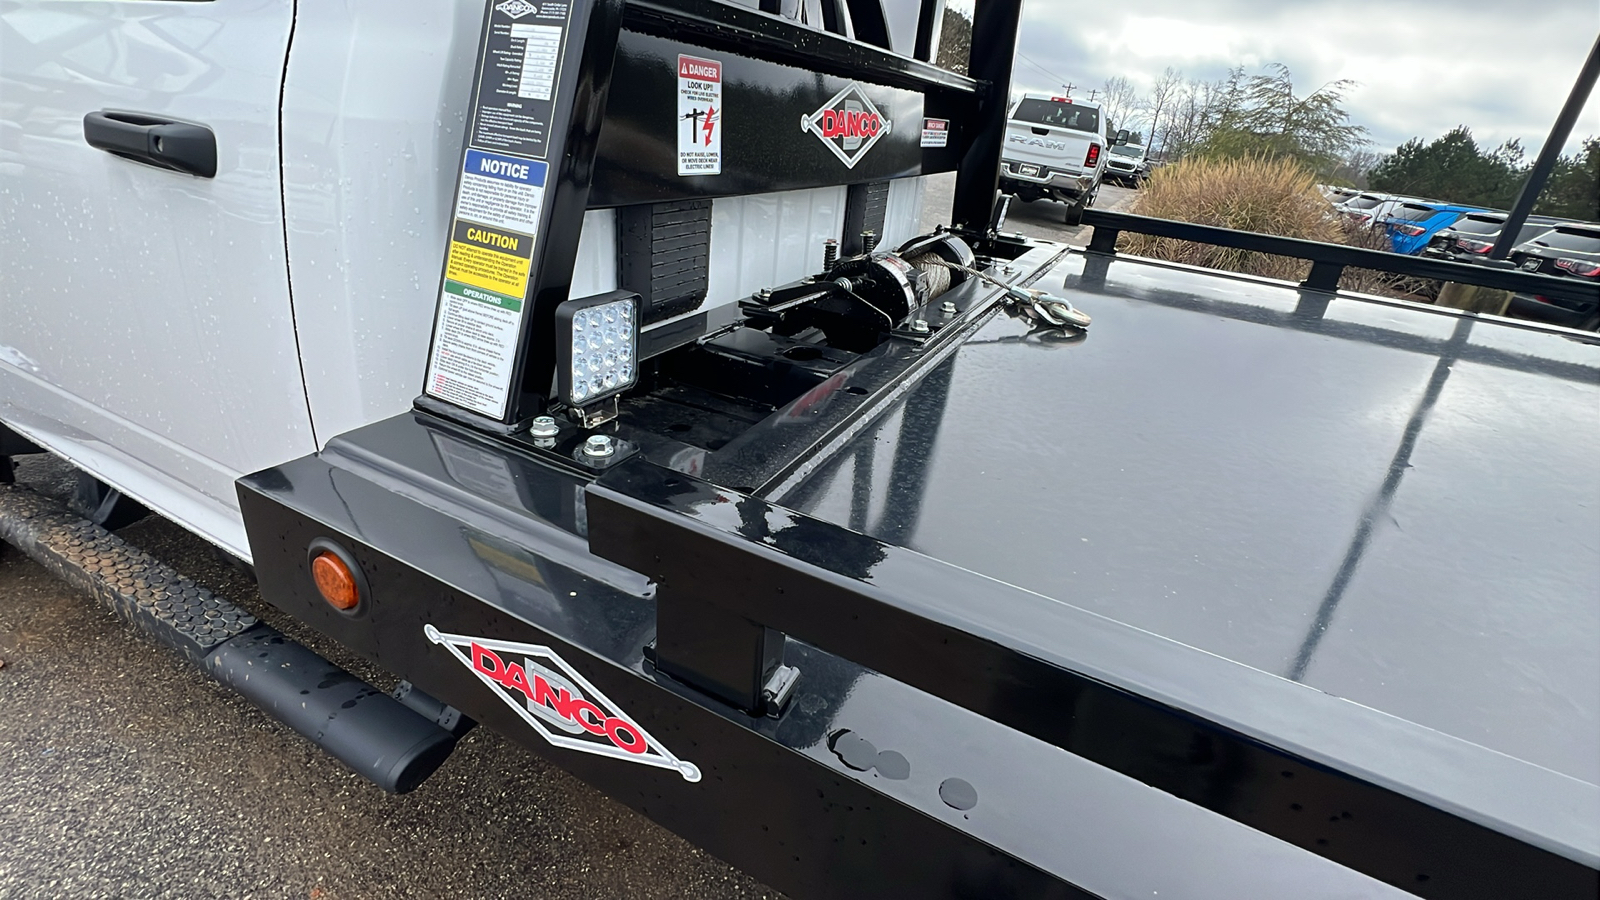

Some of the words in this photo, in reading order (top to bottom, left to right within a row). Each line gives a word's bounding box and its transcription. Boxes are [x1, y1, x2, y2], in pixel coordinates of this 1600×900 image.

[689, 64, 717, 78] DANGER
[688, 81, 702, 89] LOOK
[822, 109, 880, 138] DANCO
[1009, 134, 1066, 151] RAM
[480, 158, 530, 180] NOTICE
[467, 228, 519, 251] CAUTION
[463, 288, 502, 304] OPERATIONS
[470, 642, 648, 754] DANCO
